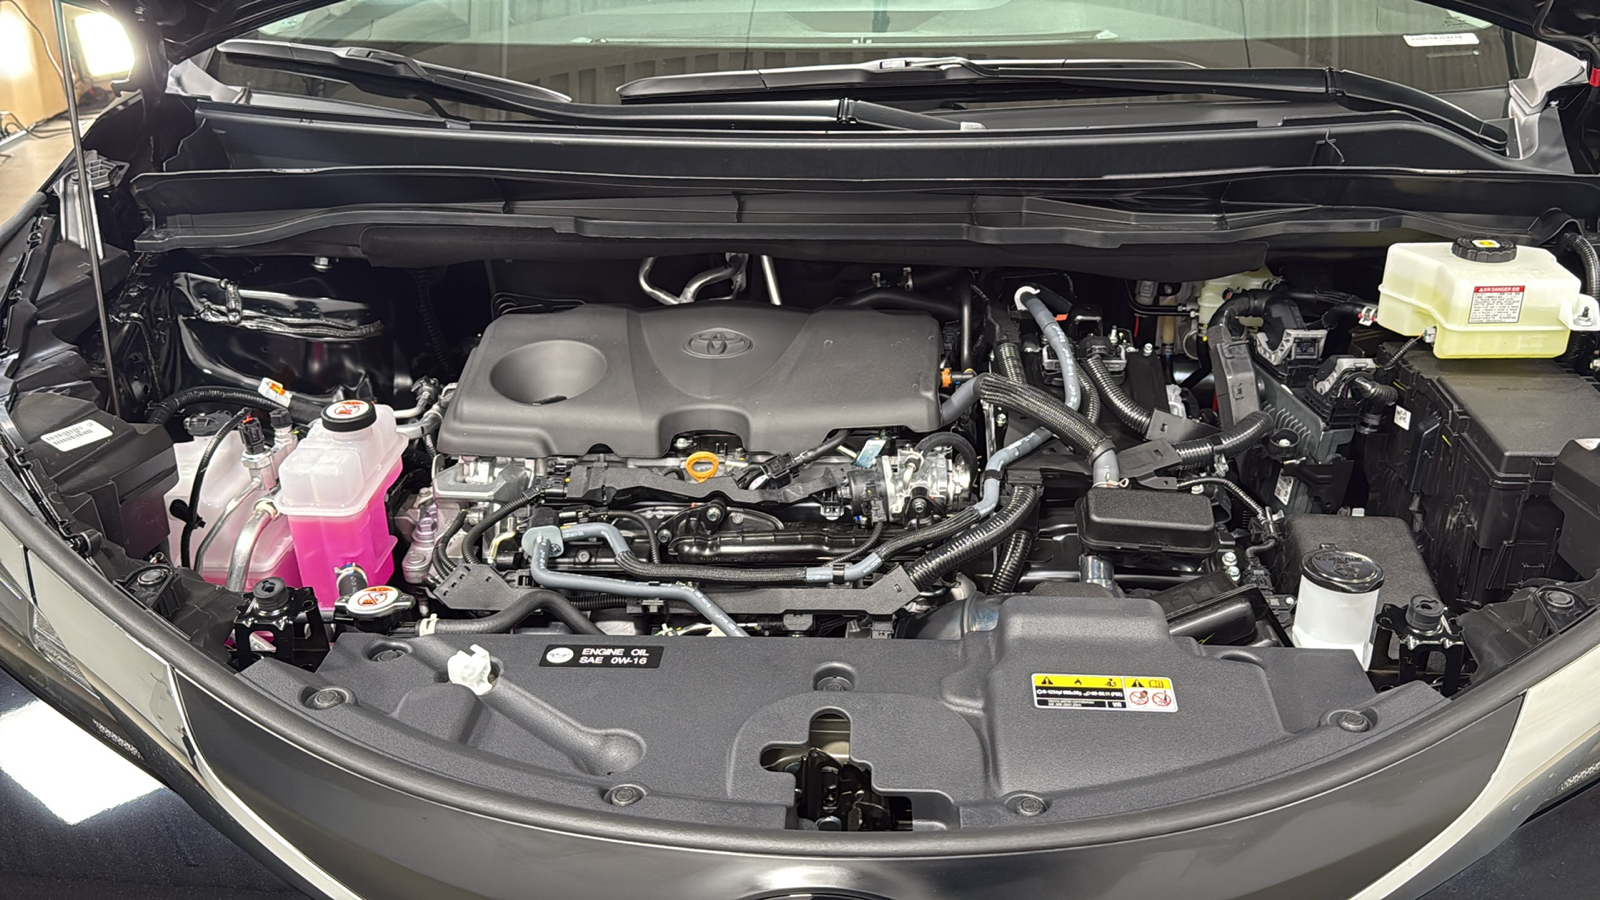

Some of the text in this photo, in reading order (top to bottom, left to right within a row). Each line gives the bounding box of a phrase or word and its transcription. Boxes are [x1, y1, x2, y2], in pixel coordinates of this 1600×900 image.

[581, 648, 650, 656] ENGINE OIL
[578, 656, 604, 664] SAE
